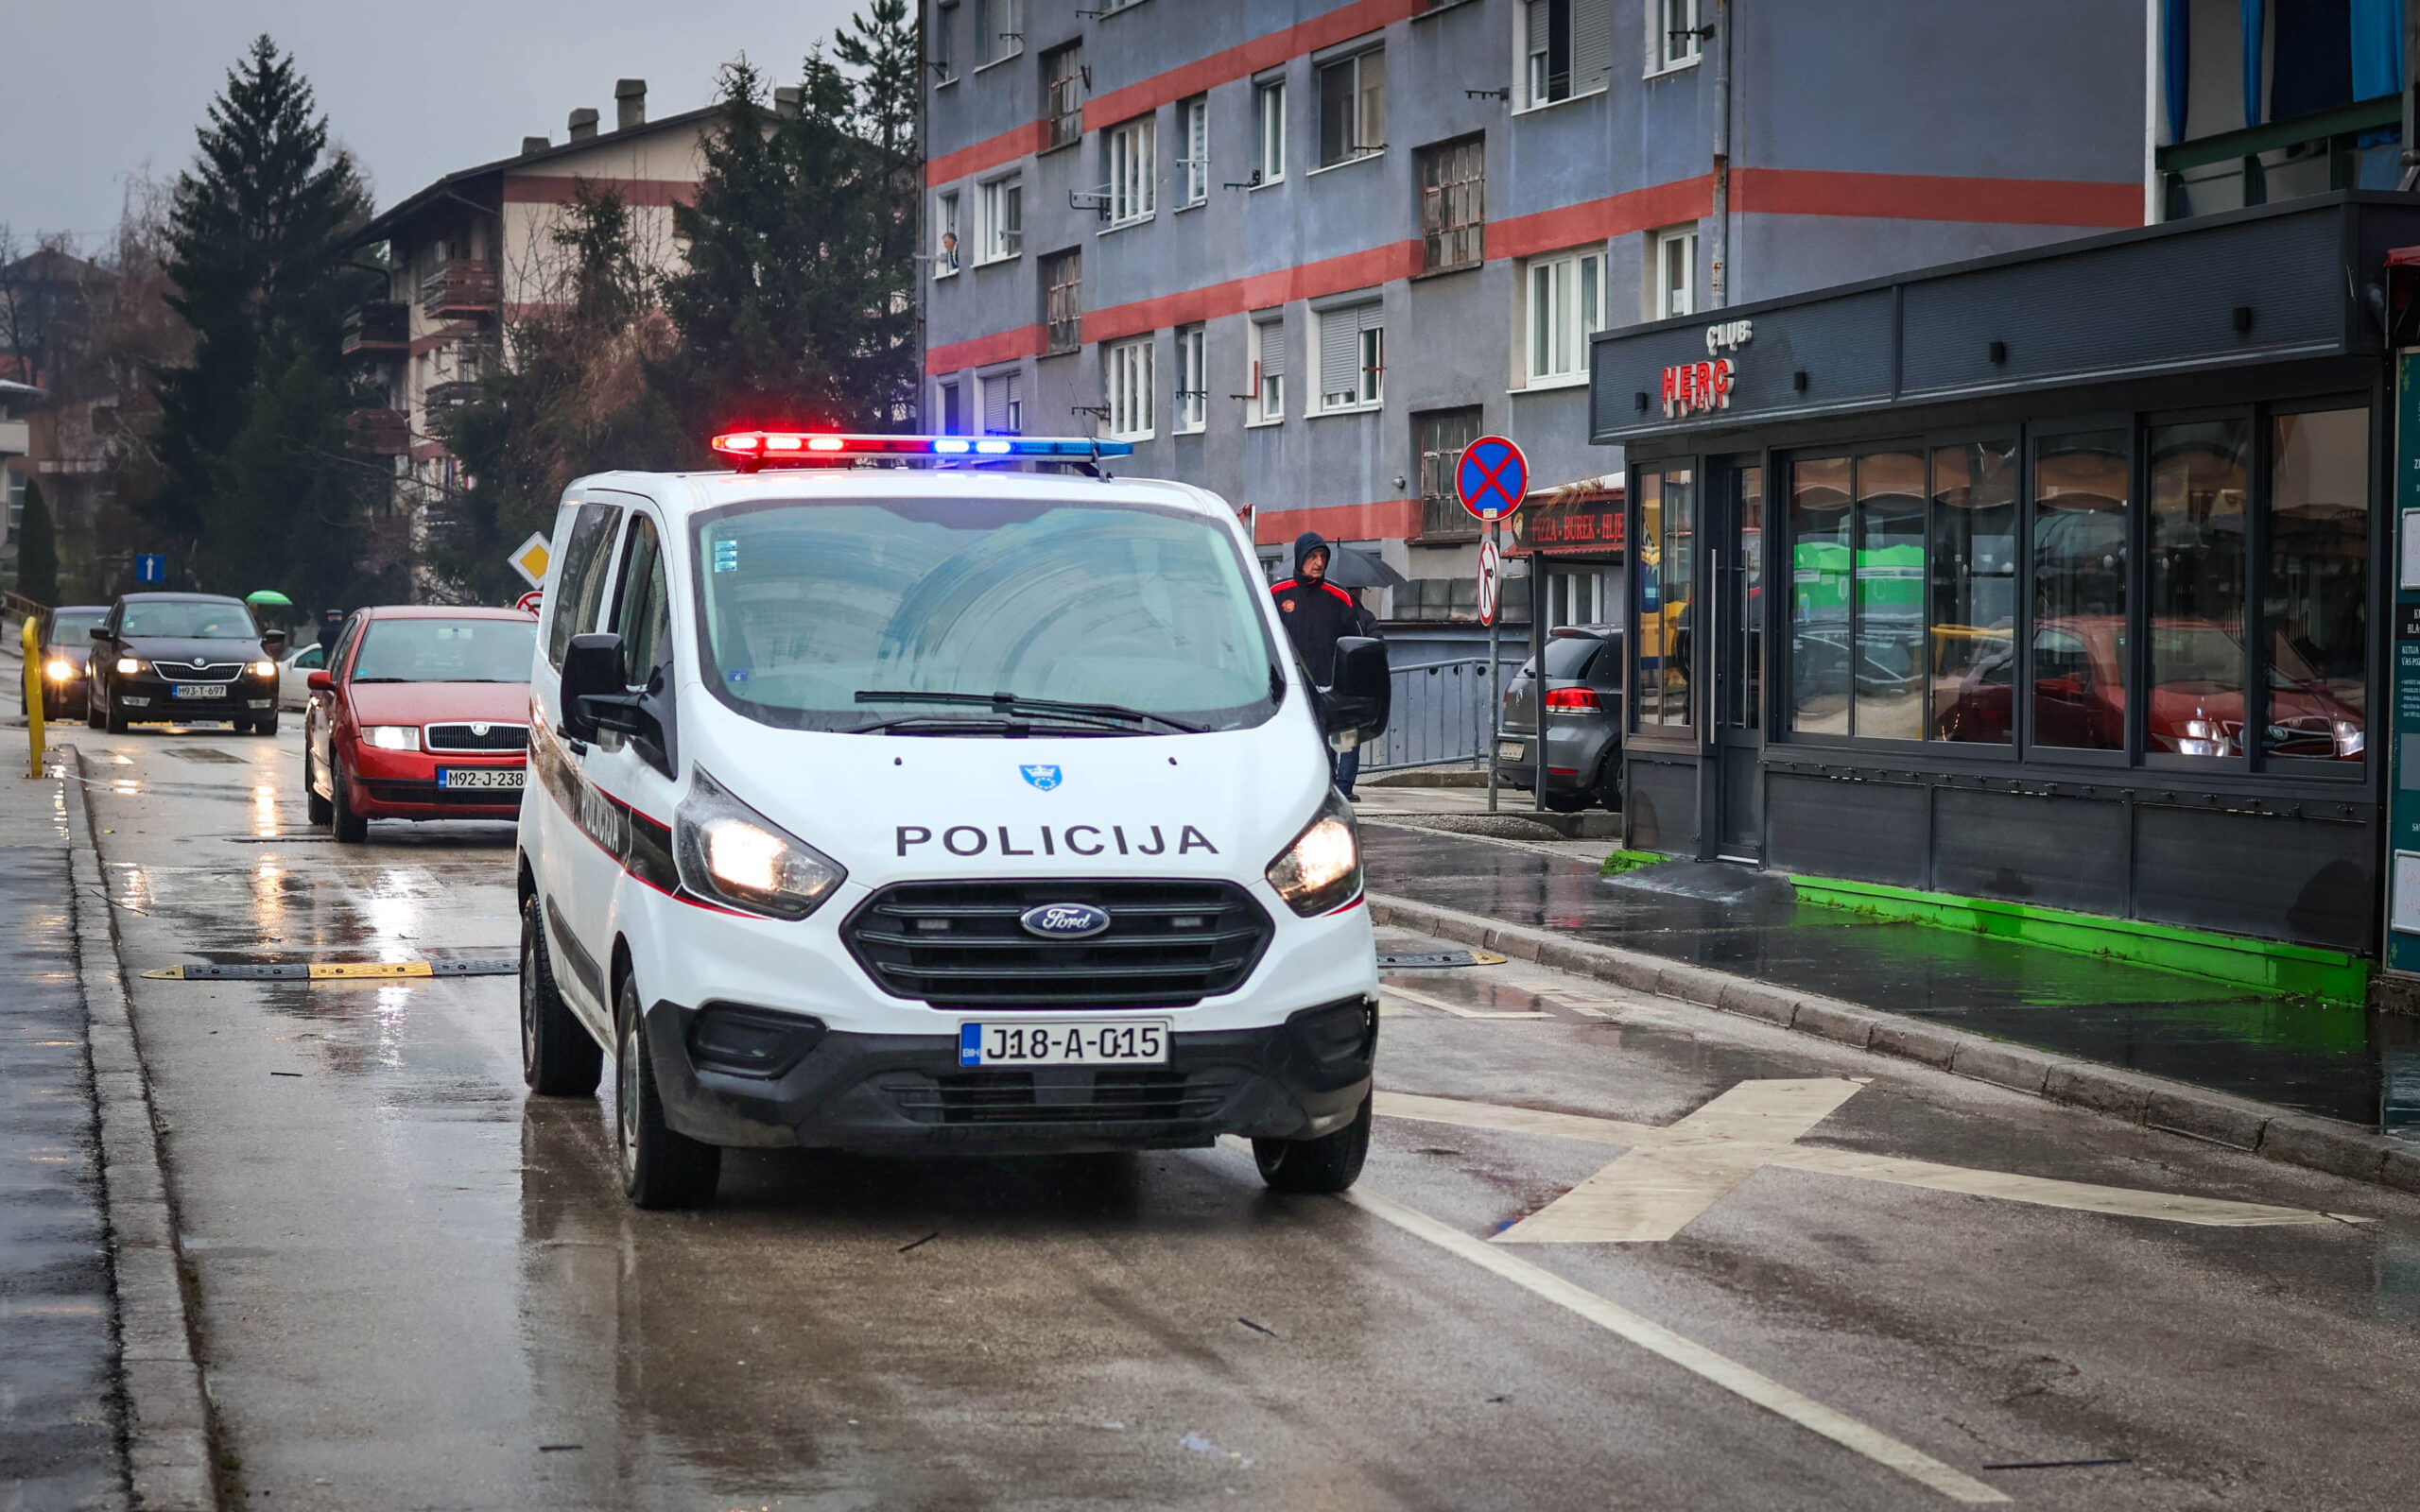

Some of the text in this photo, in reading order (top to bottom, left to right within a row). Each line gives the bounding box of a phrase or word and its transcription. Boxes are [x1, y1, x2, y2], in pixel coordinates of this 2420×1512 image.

[1706, 320, 1753, 355] CLUB
[1662, 358, 1735, 418] HERC
[1532, 517, 1558, 541] PIZZA
[1564, 514, 1597, 541] BUREK
[178, 686, 225, 696] M93-T-697
[448, 772, 524, 786] M92-J-238
[580, 784, 618, 853] POLICIJA
[896, 825, 1219, 856] POLICIJA
[1043, 908, 1091, 930] Ford
[987, 1028, 1160, 1058] J18-A-015
